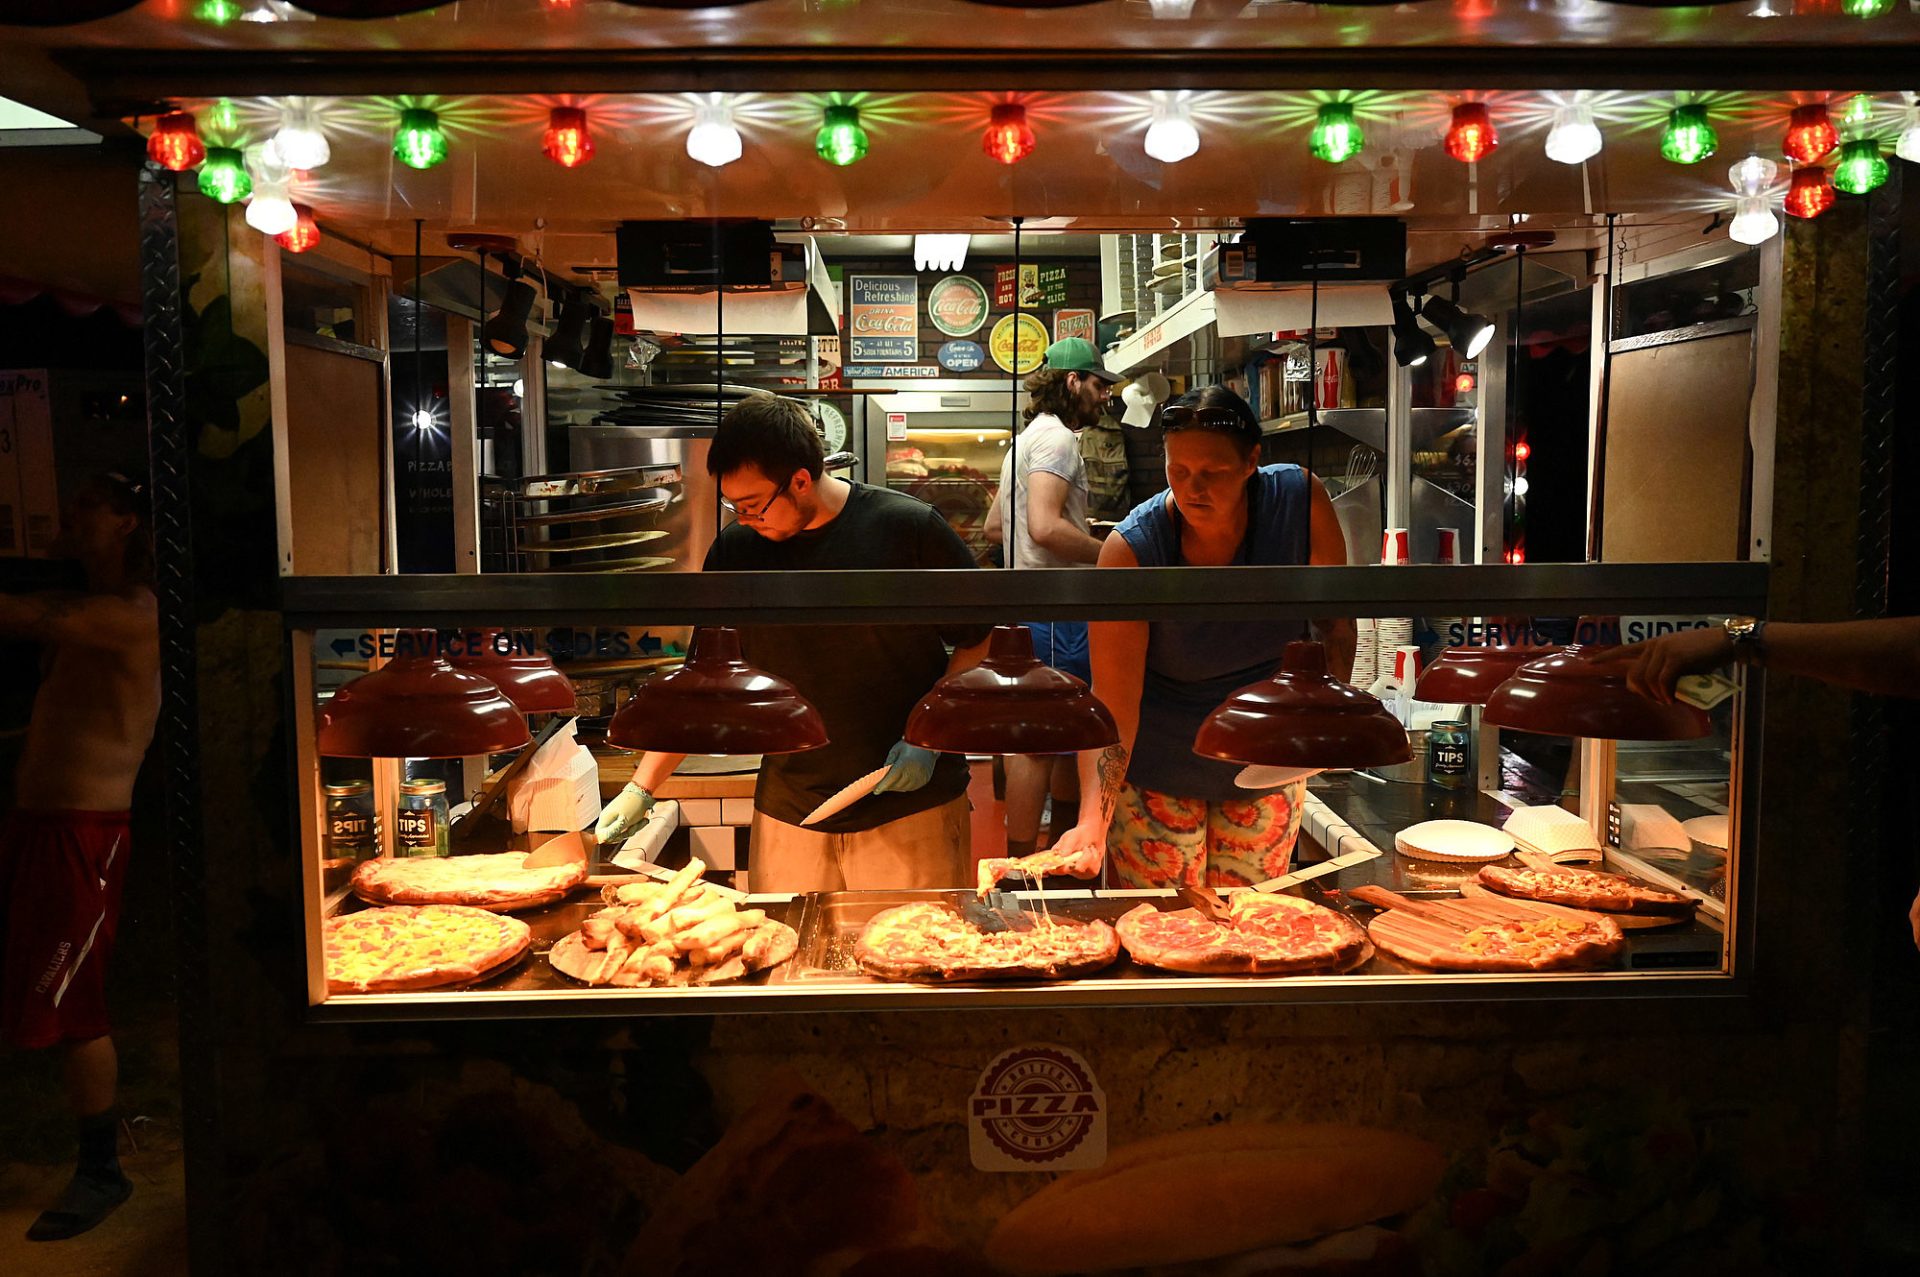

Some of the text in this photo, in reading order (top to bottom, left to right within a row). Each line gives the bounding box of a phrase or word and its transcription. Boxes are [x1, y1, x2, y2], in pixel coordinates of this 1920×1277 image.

[1040, 268, 1066, 283] PIZZA
[855, 279, 901, 291] Delicious
[864, 290, 916, 304] Refreshing
[998, 293, 1013, 304] HOT
[1047, 292, 1066, 304] SLICE
[1060, 314, 1091, 334] PIZZA
[946, 358, 978, 367] OPEN
[885, 367, 936, 377] AMERICA
[407, 460, 445, 473] PIZZA
[1449, 622, 1570, 648] SERVICE
[1578, 621, 1619, 645] ON
[358, 630, 631, 659] SERVICE ON SIDES
[1437, 751, 1464, 763] TIPS
[399, 818, 427, 833] TIPS
[973, 1094, 1100, 1117] PIZZA
